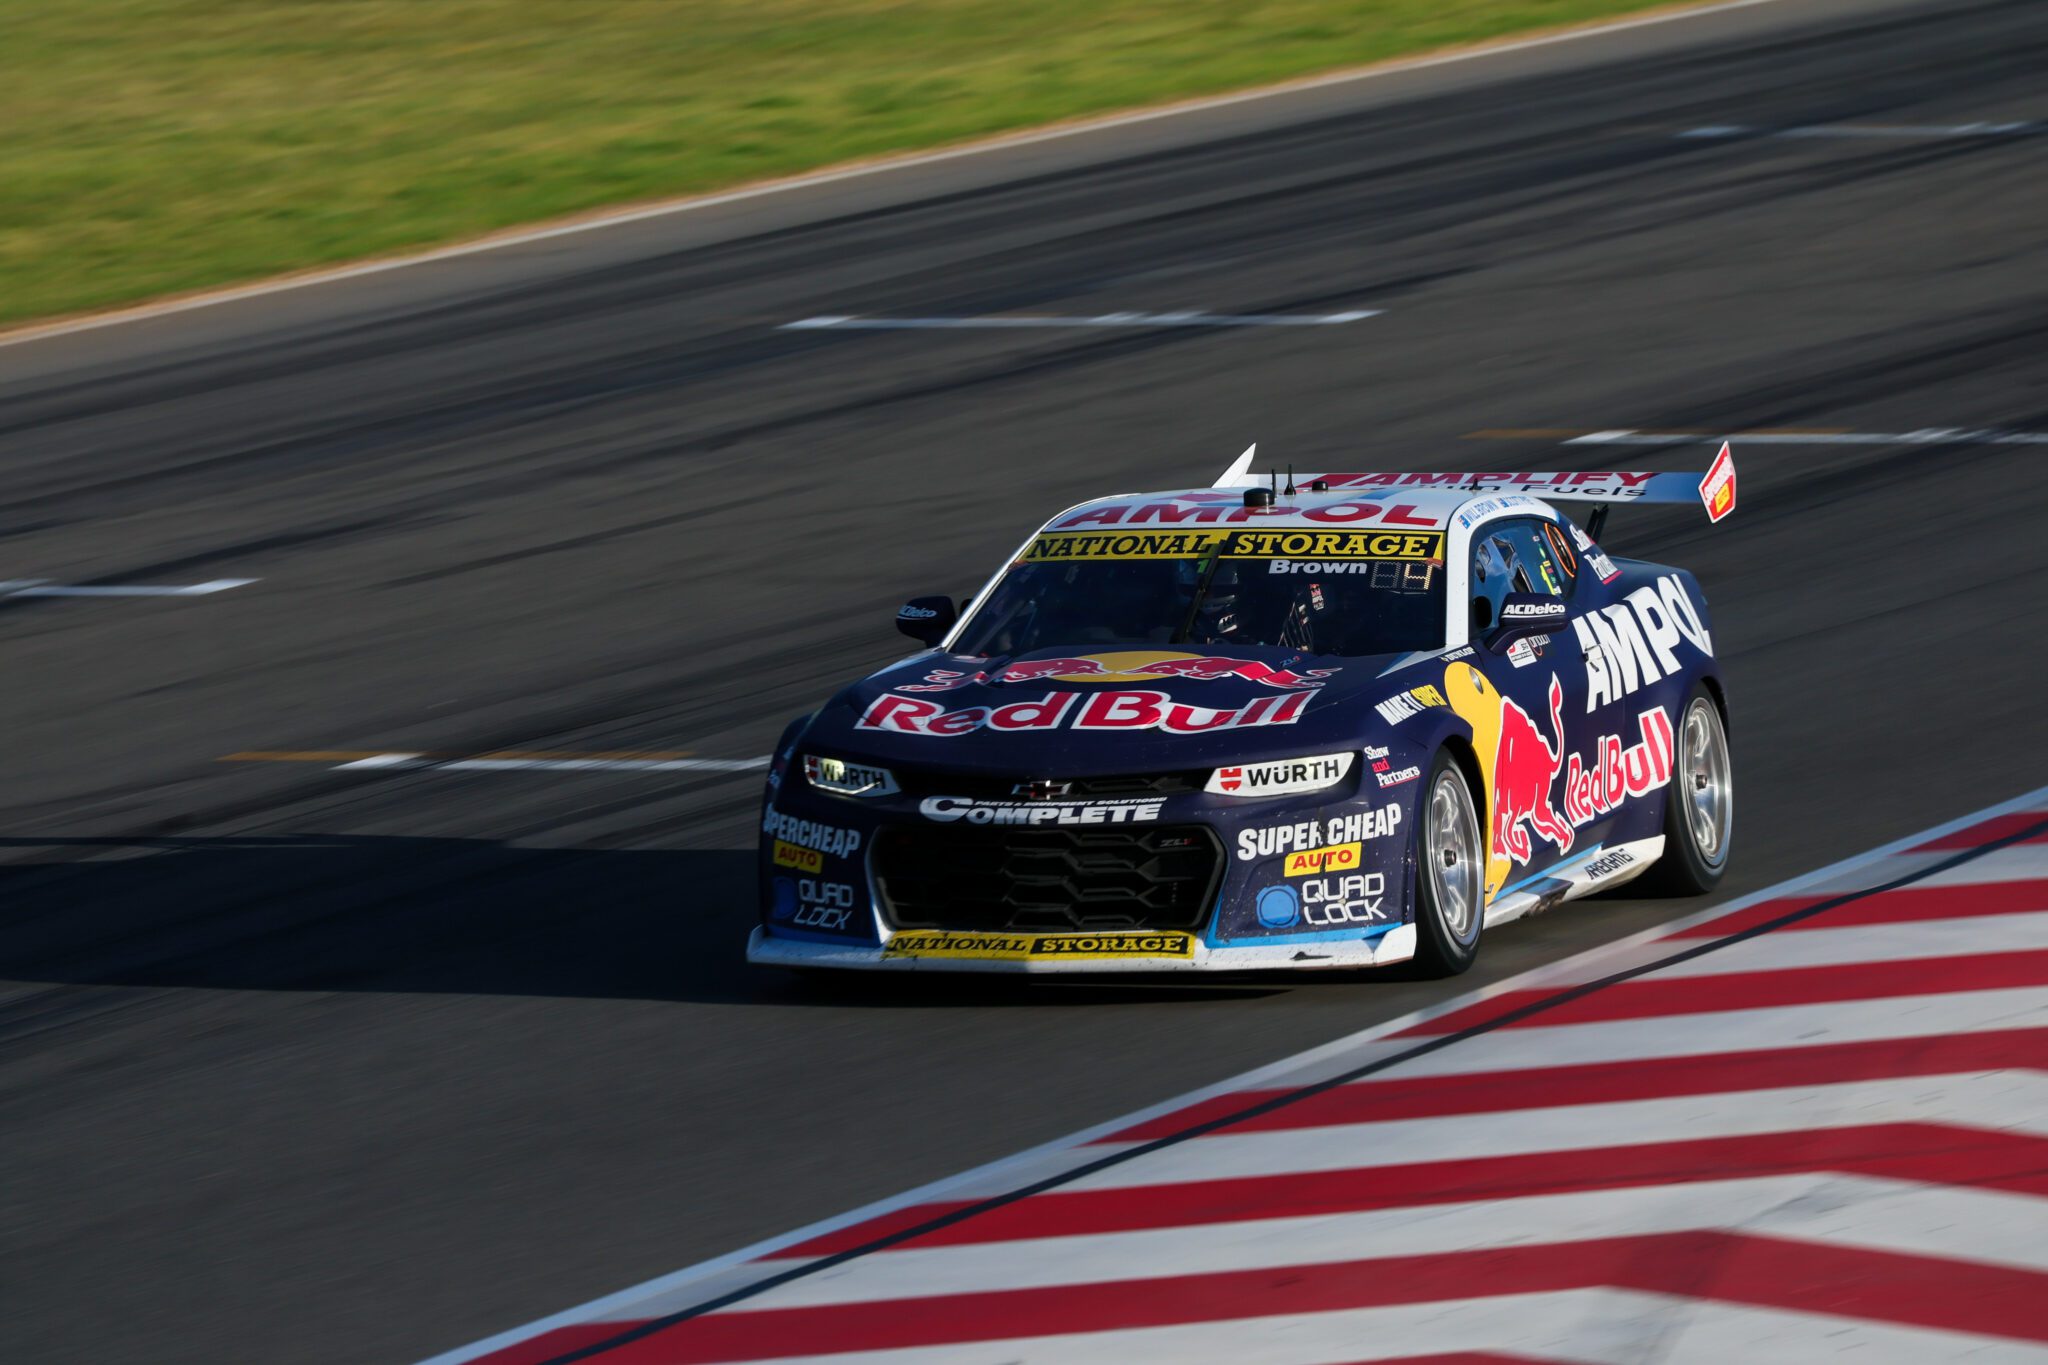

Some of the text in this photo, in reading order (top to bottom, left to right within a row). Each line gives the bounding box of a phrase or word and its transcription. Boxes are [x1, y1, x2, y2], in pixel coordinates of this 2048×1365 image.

[1348, 473, 1664, 487] AMPLIFY
[1521, 484, 1648, 497] Fuels
[1056, 502, 1438, 528] AMPOL
[1027, 533, 1429, 558] NATIONAL STORAGE
[1268, 559, 1367, 574] Brown
[1503, 603, 1565, 615] ACDelco
[1572, 574, 1714, 714] AMPOL
[1374, 695, 1418, 726] MAKE
[1247, 759, 1339, 787] WÜRTH
[1372, 757, 1391, 773] and
[1375, 765, 1420, 786] Partners
[919, 795, 1163, 824] COMPLETE
[778, 846, 817, 866] AUTO
[1292, 850, 1353, 870] AUTO
[799, 879, 853, 908] QUAD
[1302, 872, 1384, 903] QUAD
[794, 907, 853, 930] LOCK
[1303, 897, 1387, 925] LOCK
[889, 937, 1182, 953] NATIONAL STORAGE
